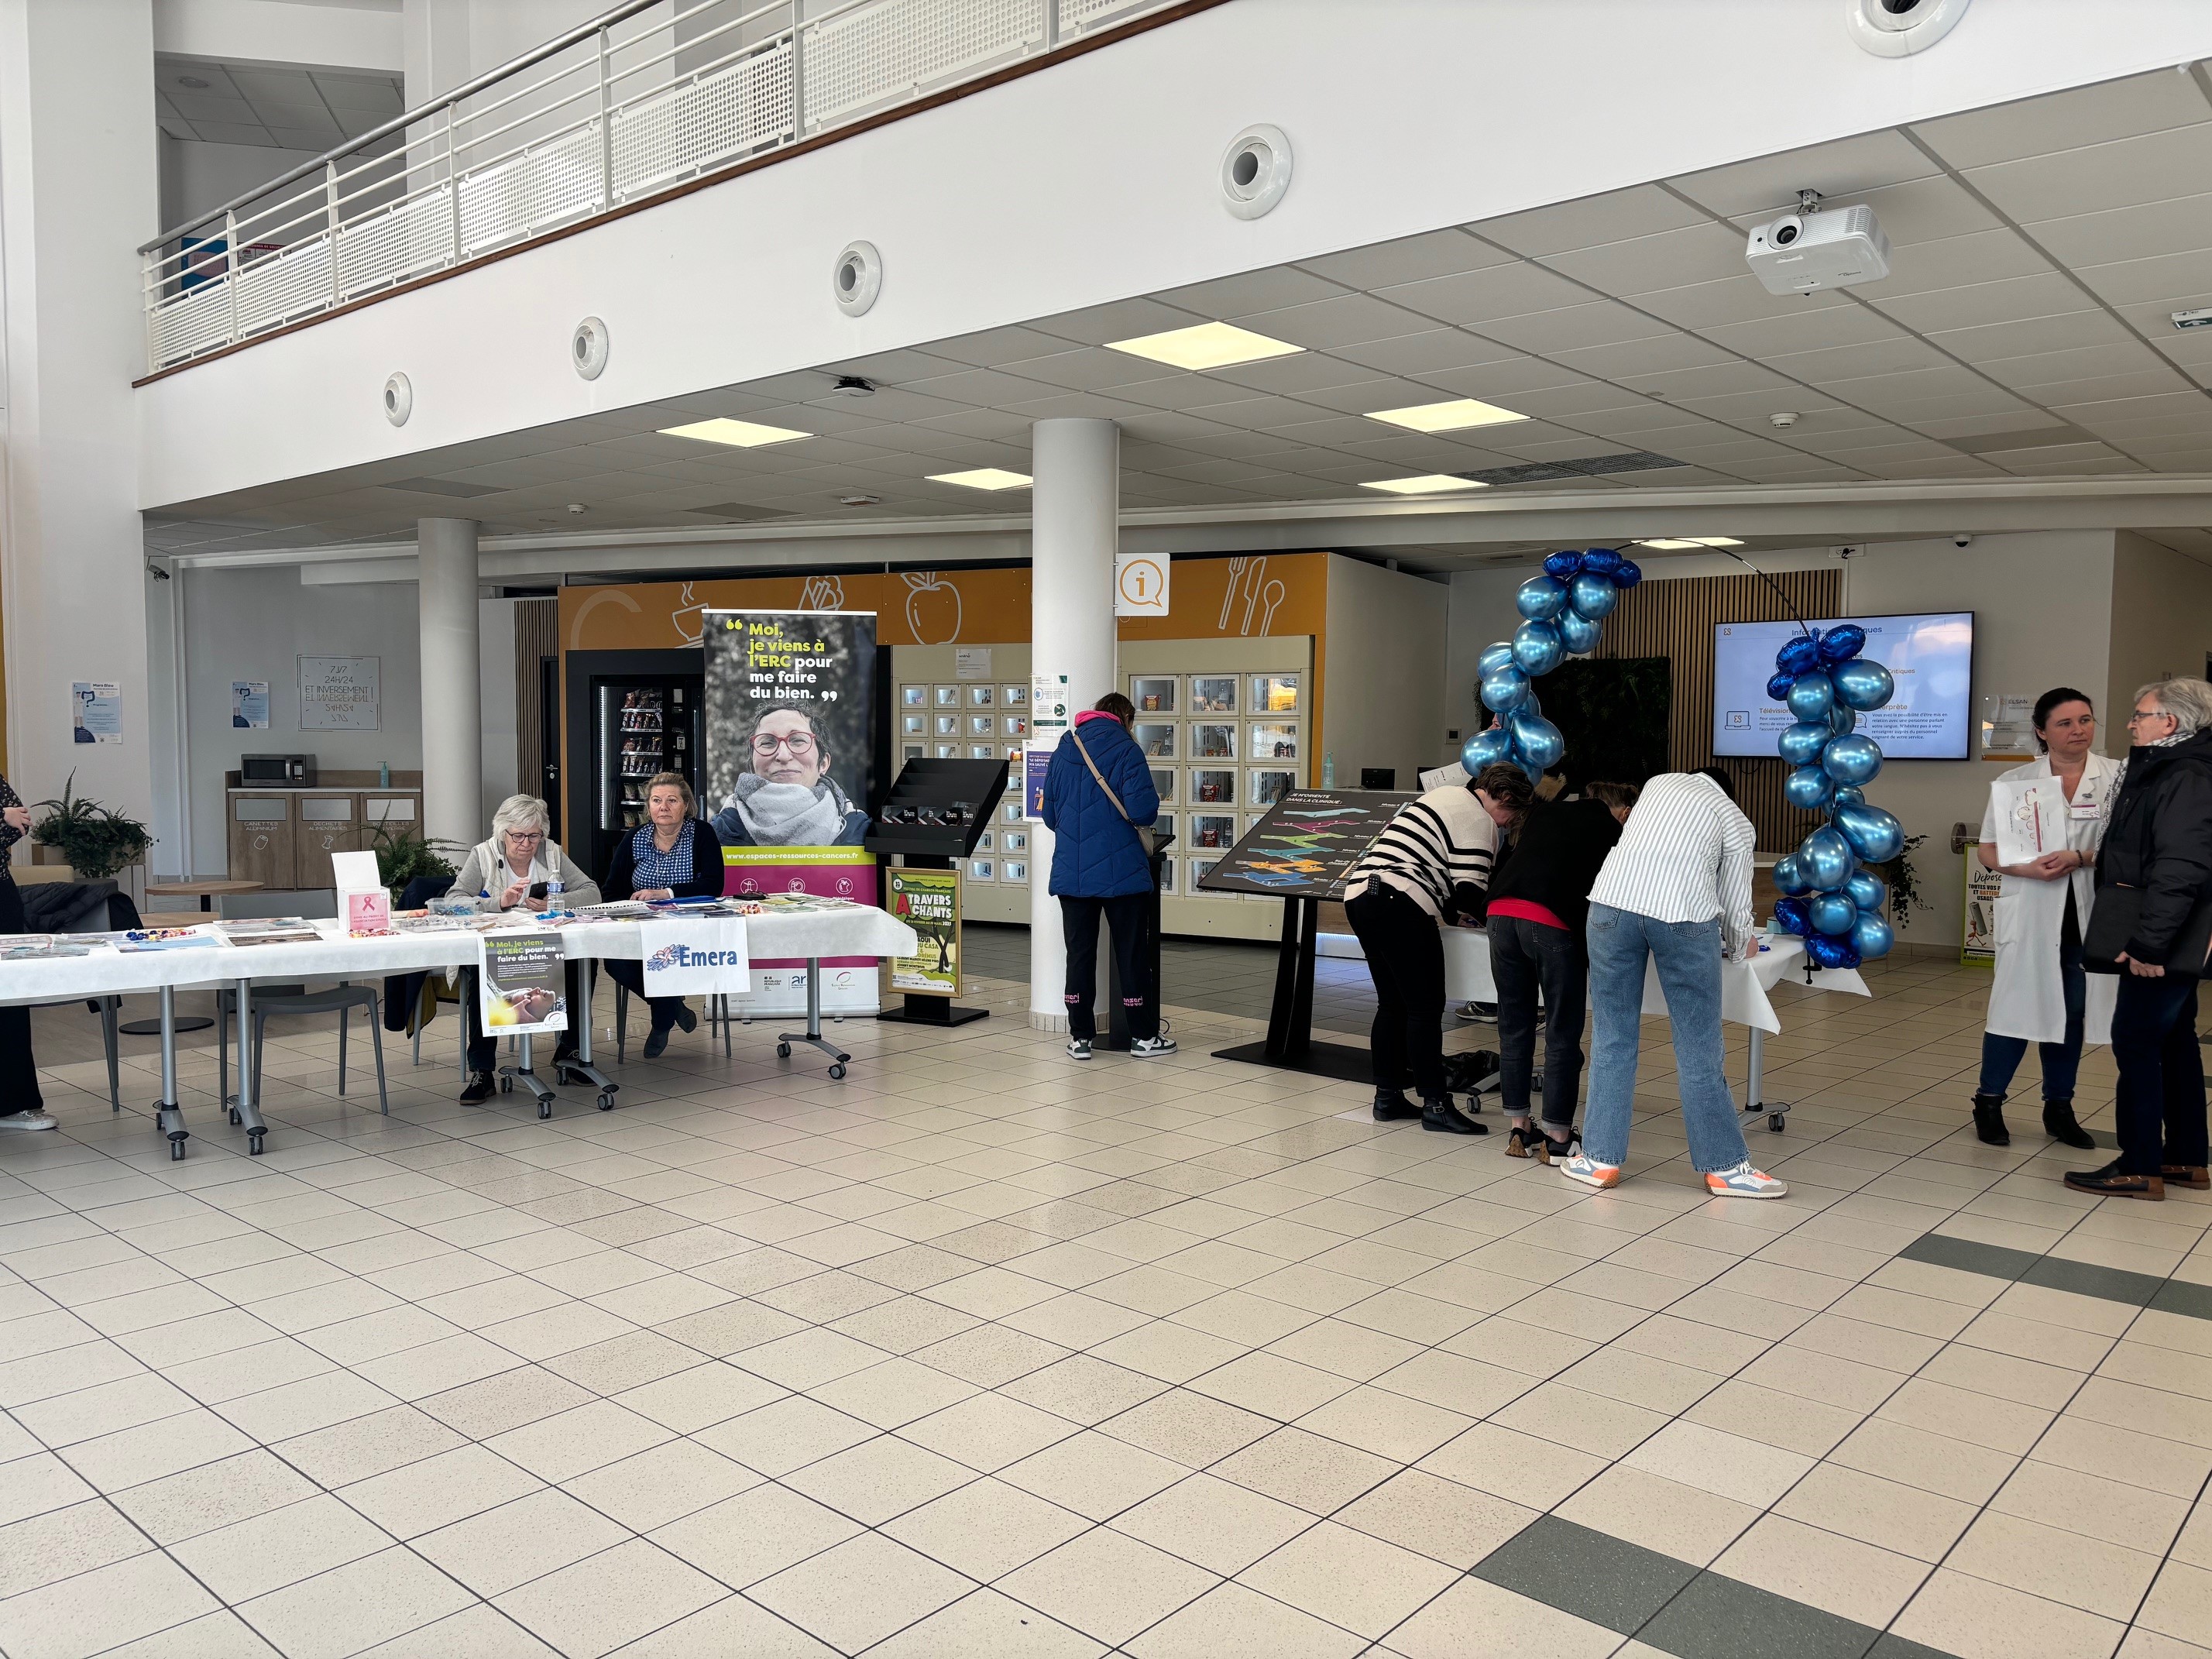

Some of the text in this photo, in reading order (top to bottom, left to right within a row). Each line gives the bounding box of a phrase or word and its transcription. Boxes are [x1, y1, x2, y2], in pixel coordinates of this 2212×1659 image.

[749, 623, 784, 638] Moi,
[747, 639, 825, 654] je viens à
[749, 655, 833, 670] l'ERC pour
[749, 670, 817, 683] me faire
[749, 686, 814, 699] du bien.
[726, 852, 858, 860] www.espaces-ressources-cancers.fr
[896, 893, 951, 915] A TRAVERS
[912, 905, 952, 919] CHANTS
[679, 946, 738, 967] Emera
[792, 976, 807, 984] ar
